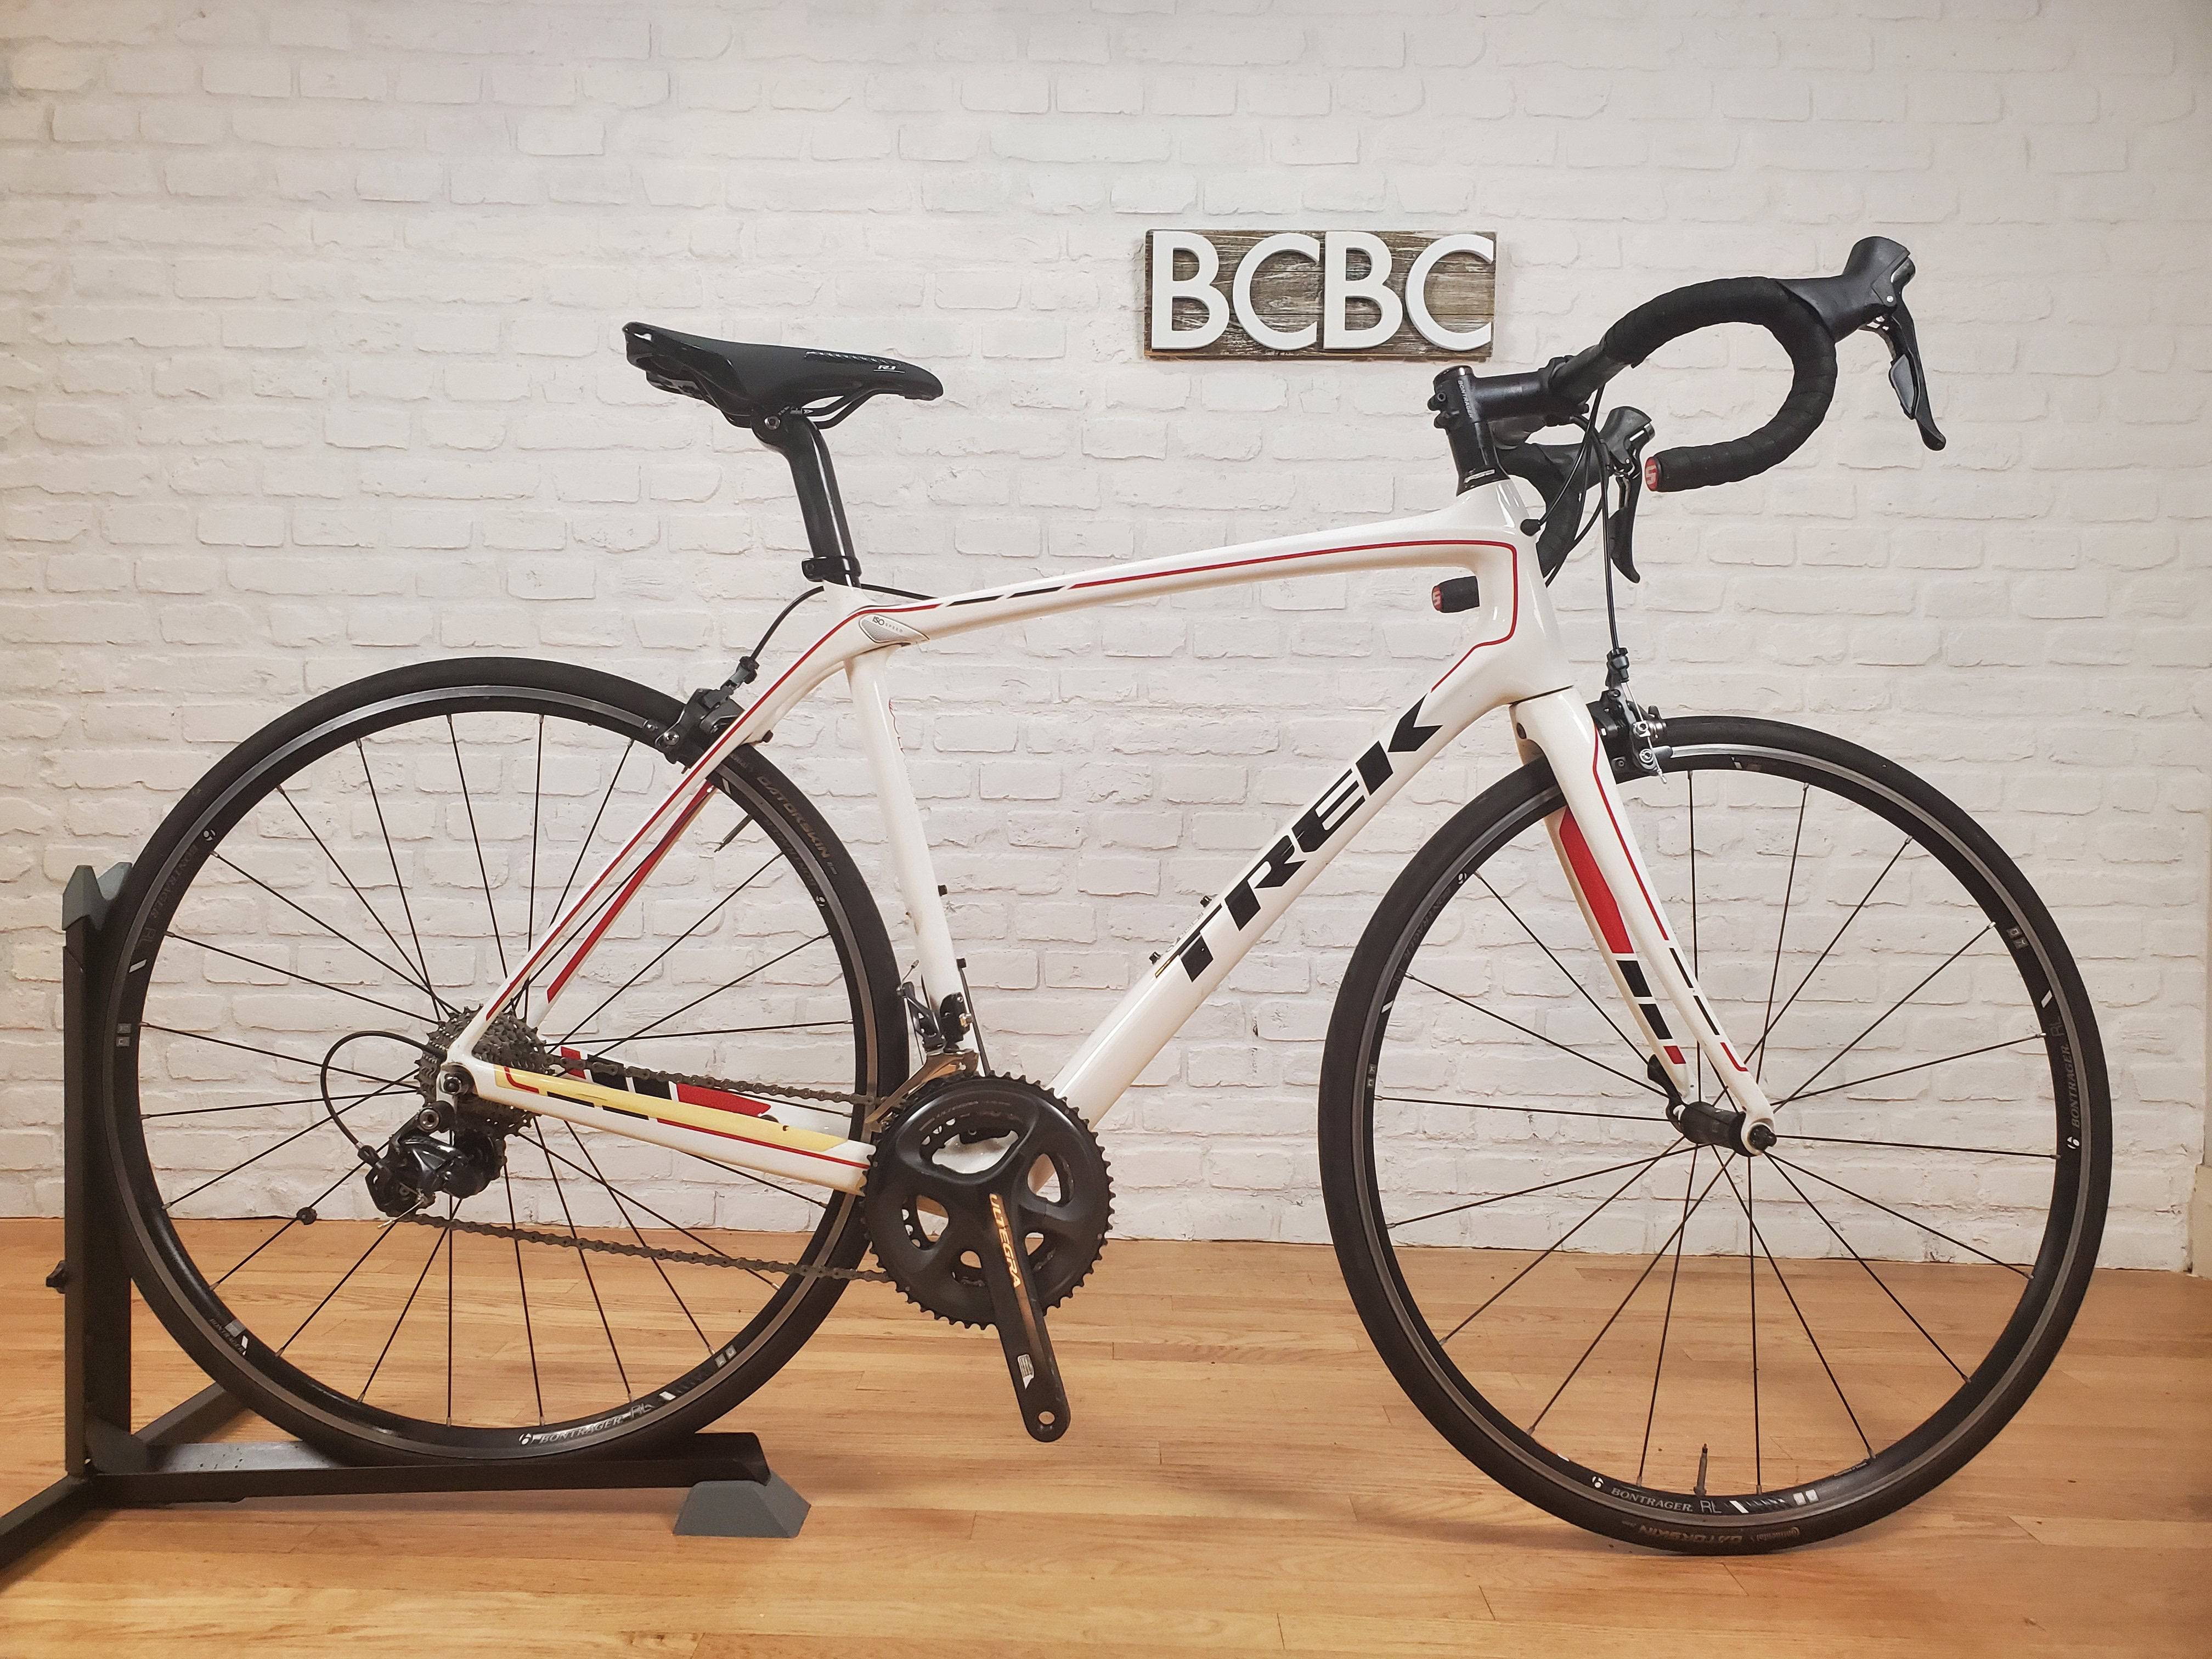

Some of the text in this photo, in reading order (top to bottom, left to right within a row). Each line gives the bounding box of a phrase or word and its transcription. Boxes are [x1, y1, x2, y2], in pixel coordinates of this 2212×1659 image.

[1151, 231, 1494, 351] BCBC
[1457, 380, 1474, 419] BONTRAGER
[1154, 692, 1443, 983] TREK
[2061, 1043, 2081, 1129] BONTRAGER
[989, 1193, 1021, 1288] ULTEGRA
[539, 1417, 623, 1444] BONTRAGER
[1611, 1487, 1722, 1514] BONTRAGER RL
